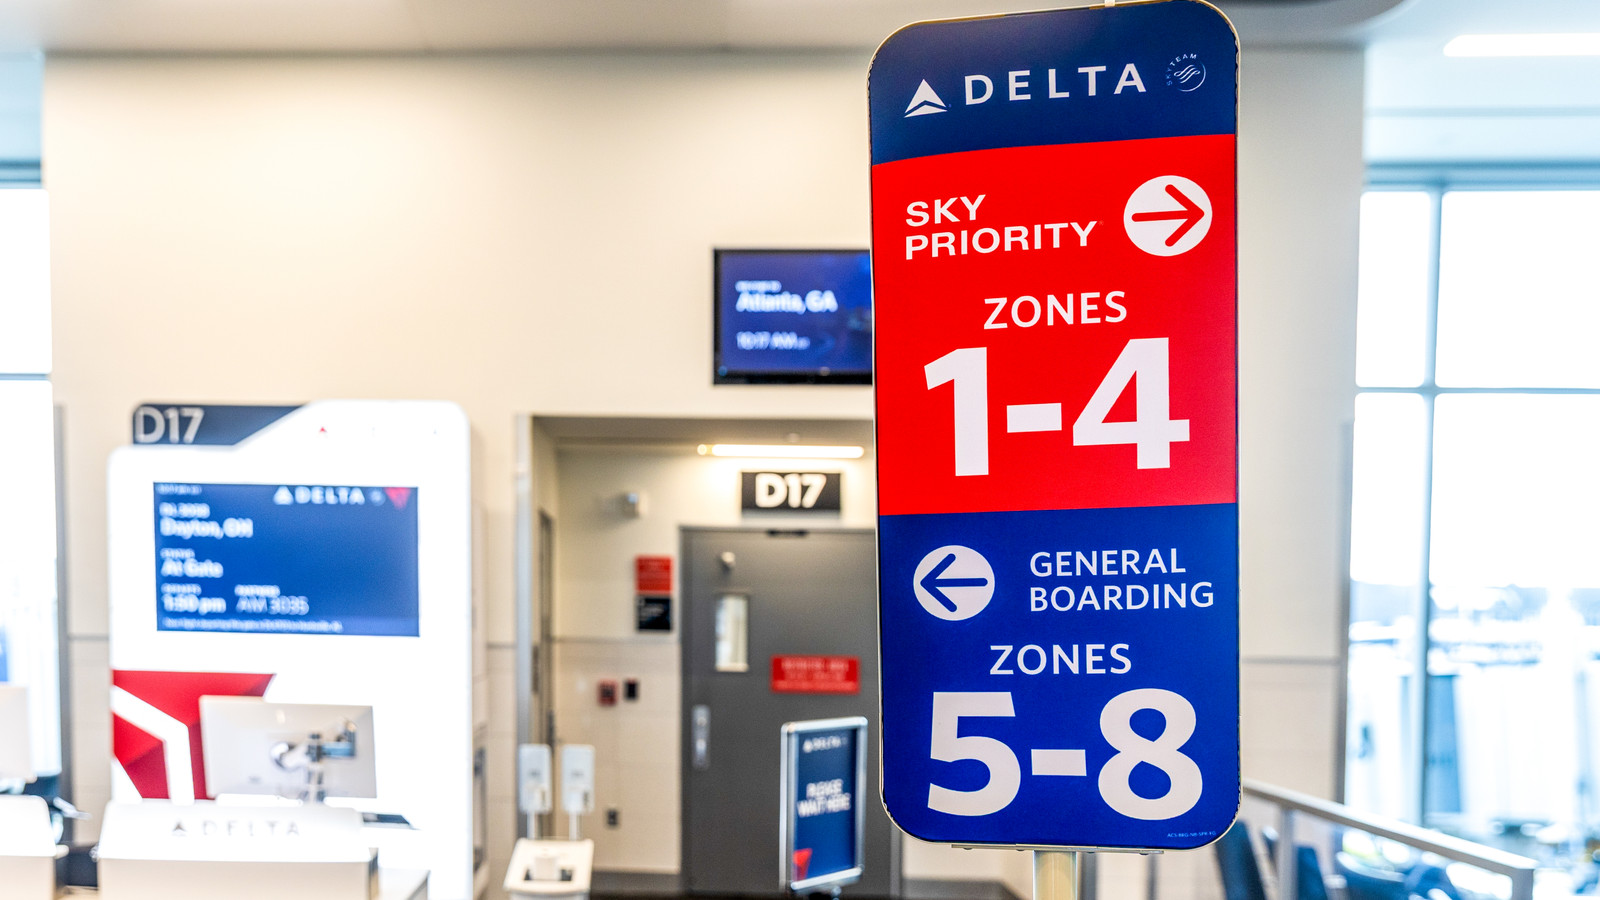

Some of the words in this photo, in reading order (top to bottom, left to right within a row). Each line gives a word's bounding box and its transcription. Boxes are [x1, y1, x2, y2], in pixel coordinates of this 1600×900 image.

[964, 63, 1147, 106] DELTA
[905, 194, 986, 227] SKY
[905, 220, 1098, 260] PRIORITY
[805, 289, 838, 313] GA
[983, 290, 1128, 330] ZONES
[134, 405, 205, 445] D17
[924, 336, 1190, 477] 1-4
[294, 486, 366, 505] DELTA
[754, 472, 827, 509] D17
[1029, 547, 1186, 578] GENERAL
[1029, 581, 1214, 612] BOARDING
[989, 643, 1132, 676] ZONES
[926, 687, 1203, 821] 5-8
